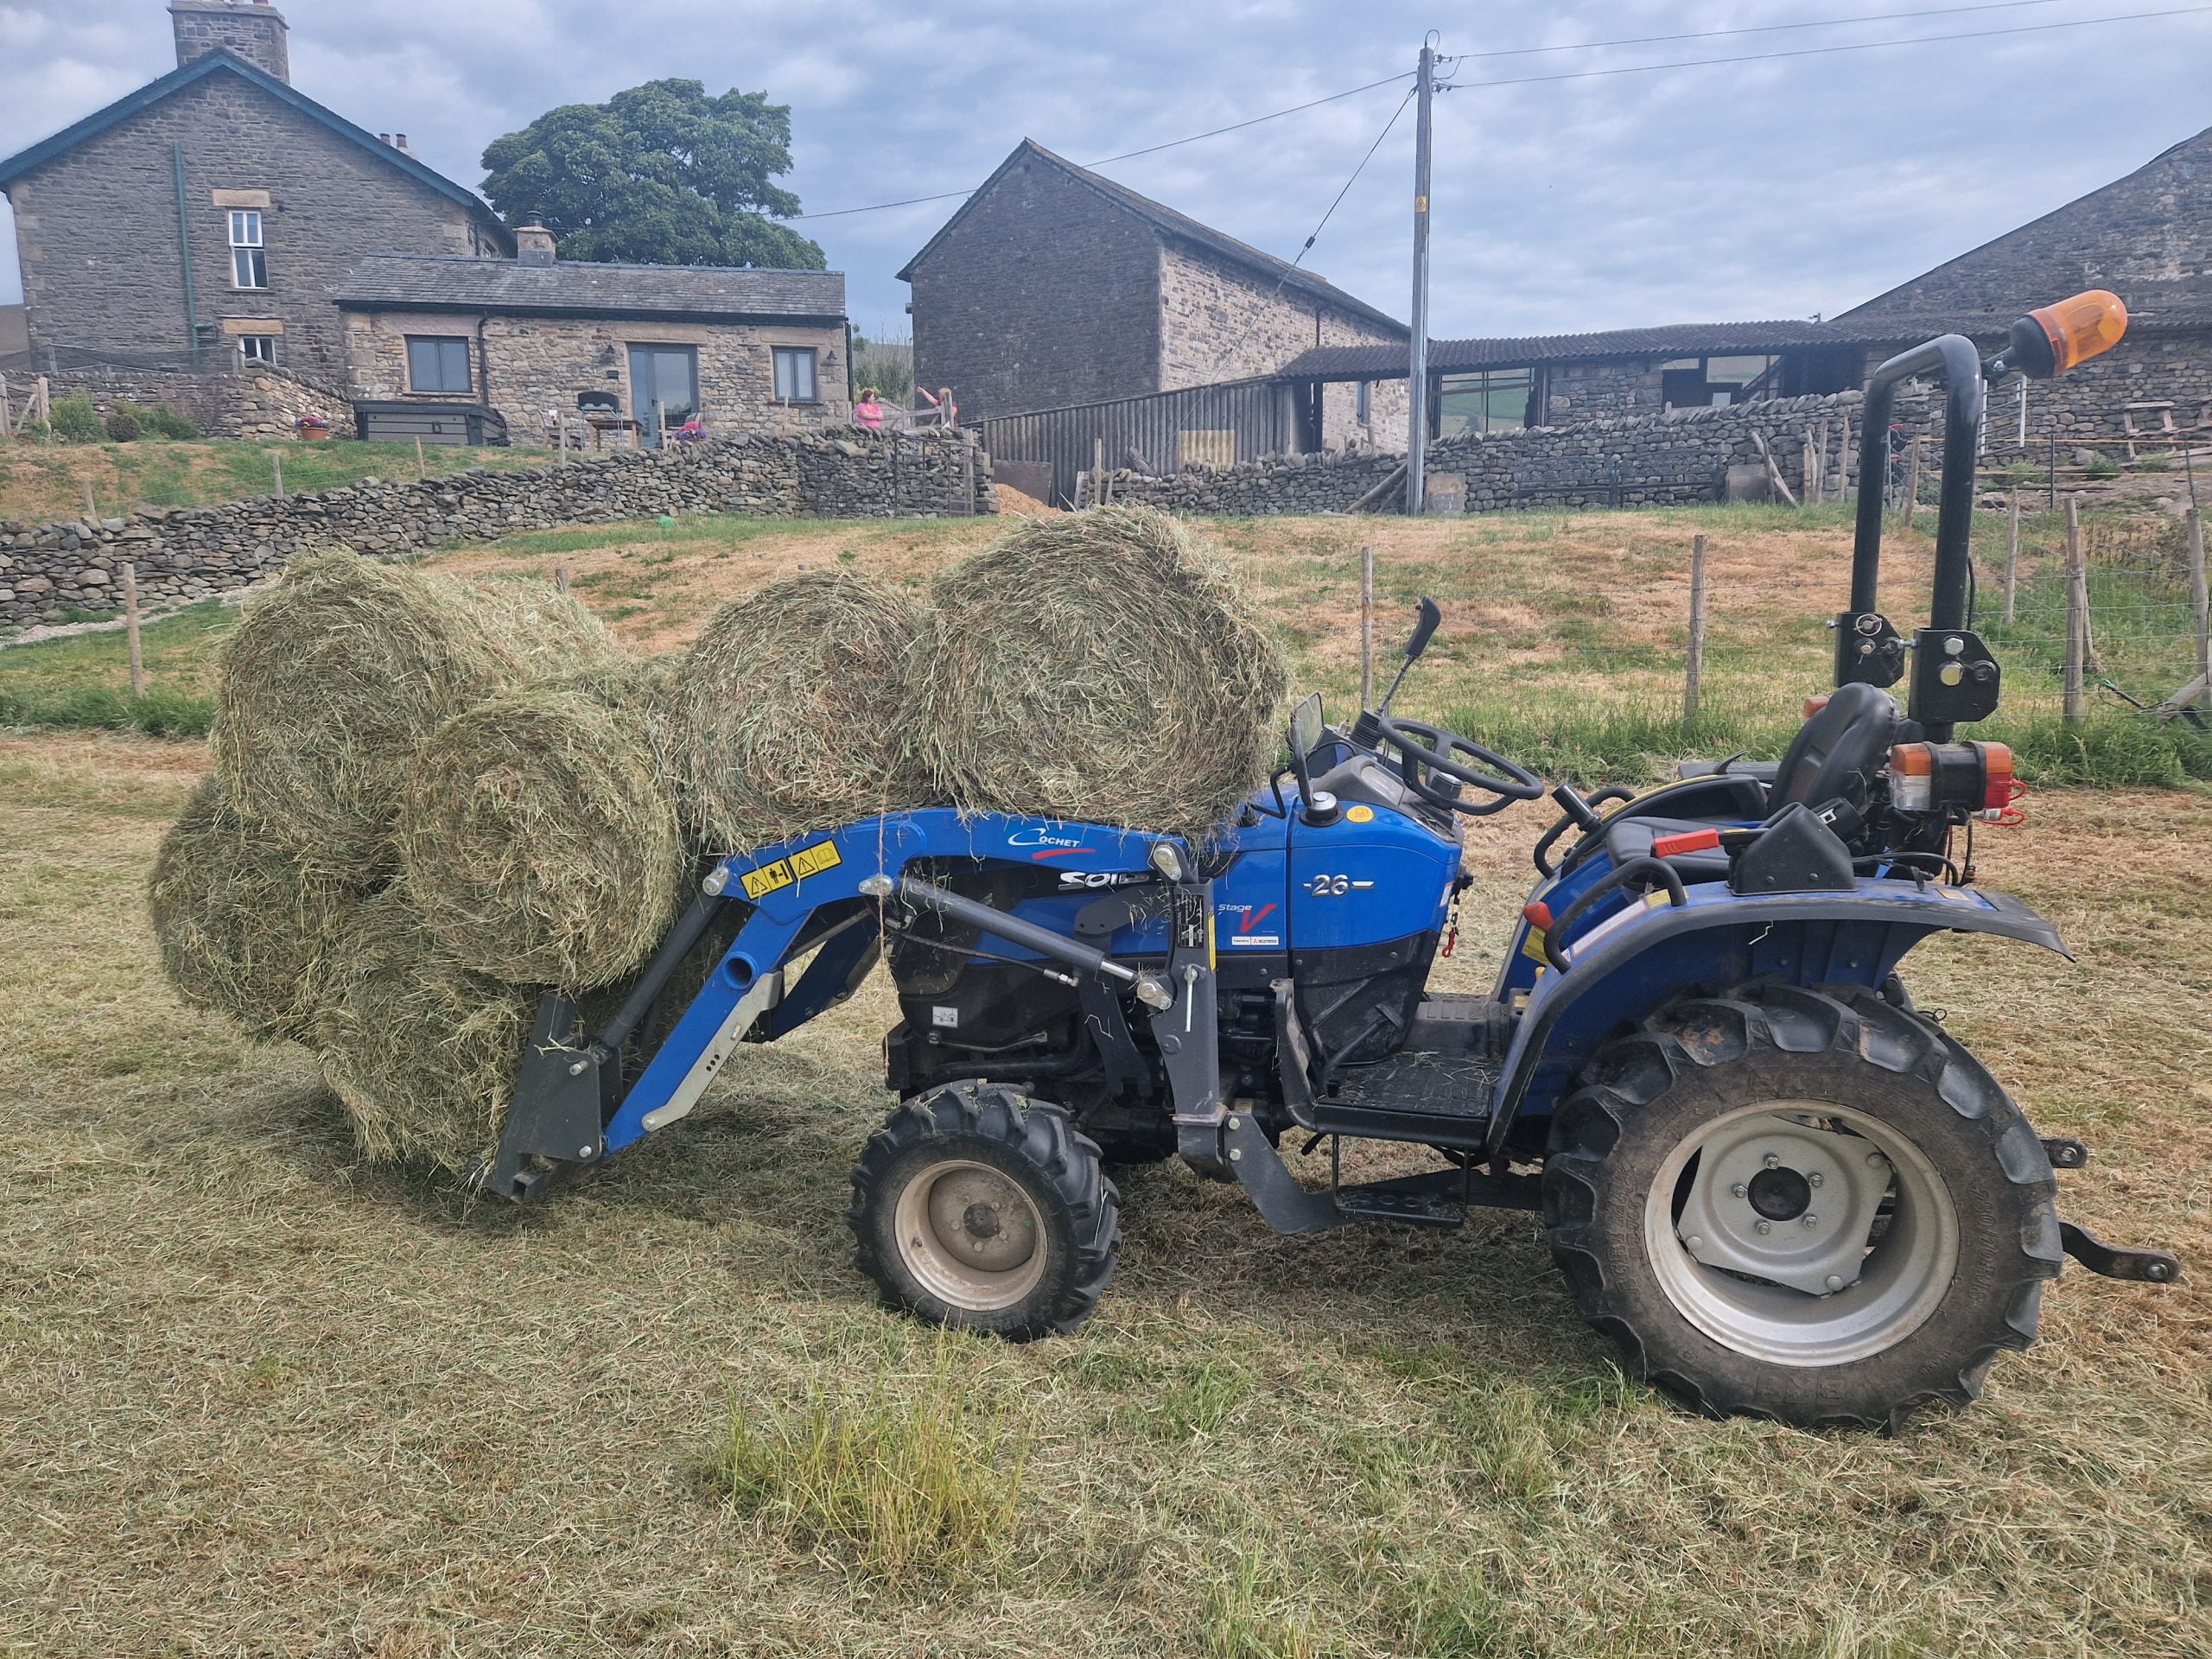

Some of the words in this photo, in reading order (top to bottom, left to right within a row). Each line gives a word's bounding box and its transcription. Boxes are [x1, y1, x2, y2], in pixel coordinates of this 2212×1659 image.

[1007, 828, 1080, 848] COCHET
[1218, 904, 1252, 912] Stage
[1239, 903, 1277, 933] V
